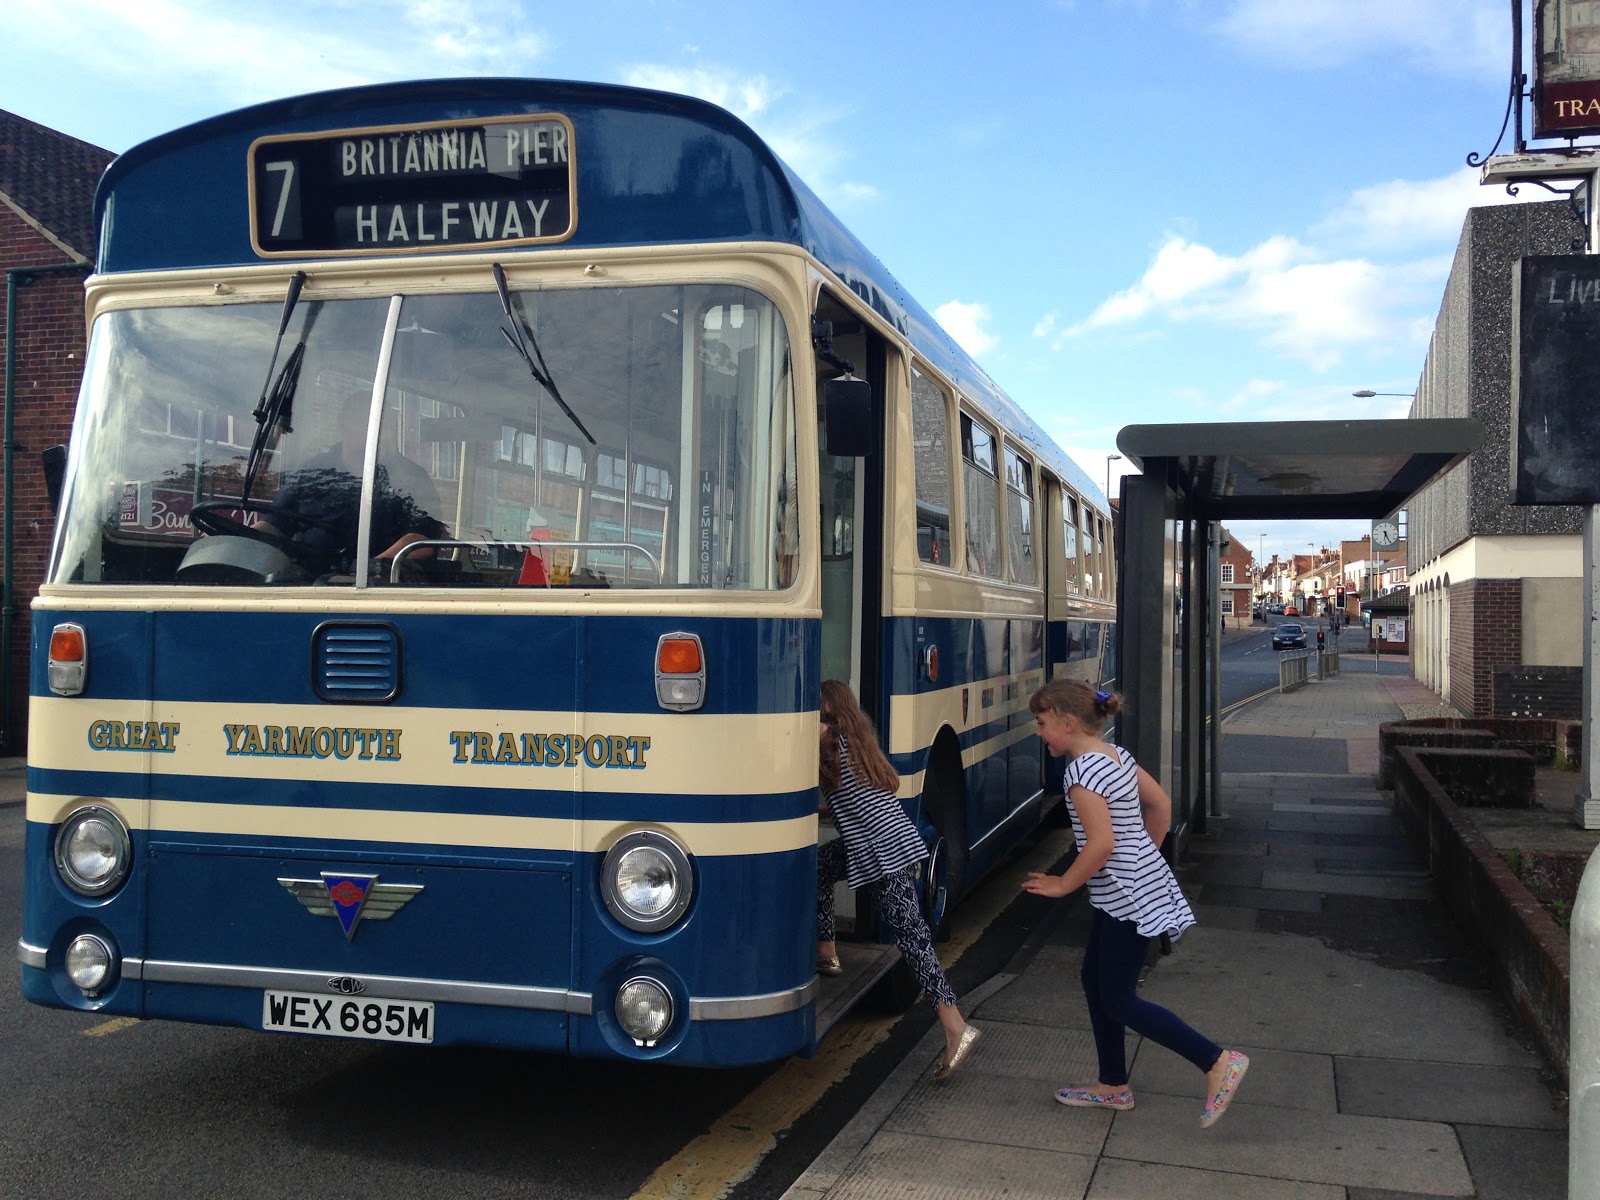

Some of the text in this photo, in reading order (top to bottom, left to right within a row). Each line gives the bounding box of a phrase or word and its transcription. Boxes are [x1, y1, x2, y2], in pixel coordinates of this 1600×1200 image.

[342, 124, 568, 176] BRITANNIA PIER
[266, 161, 295, 236] 7
[356, 200, 549, 242] HALFWAY
[88, 720, 651, 769] GREAT YARMOUTH TRANSPORT
[329, 977, 364, 993] ECW
[270, 994, 429, 1039] WEX 685M
